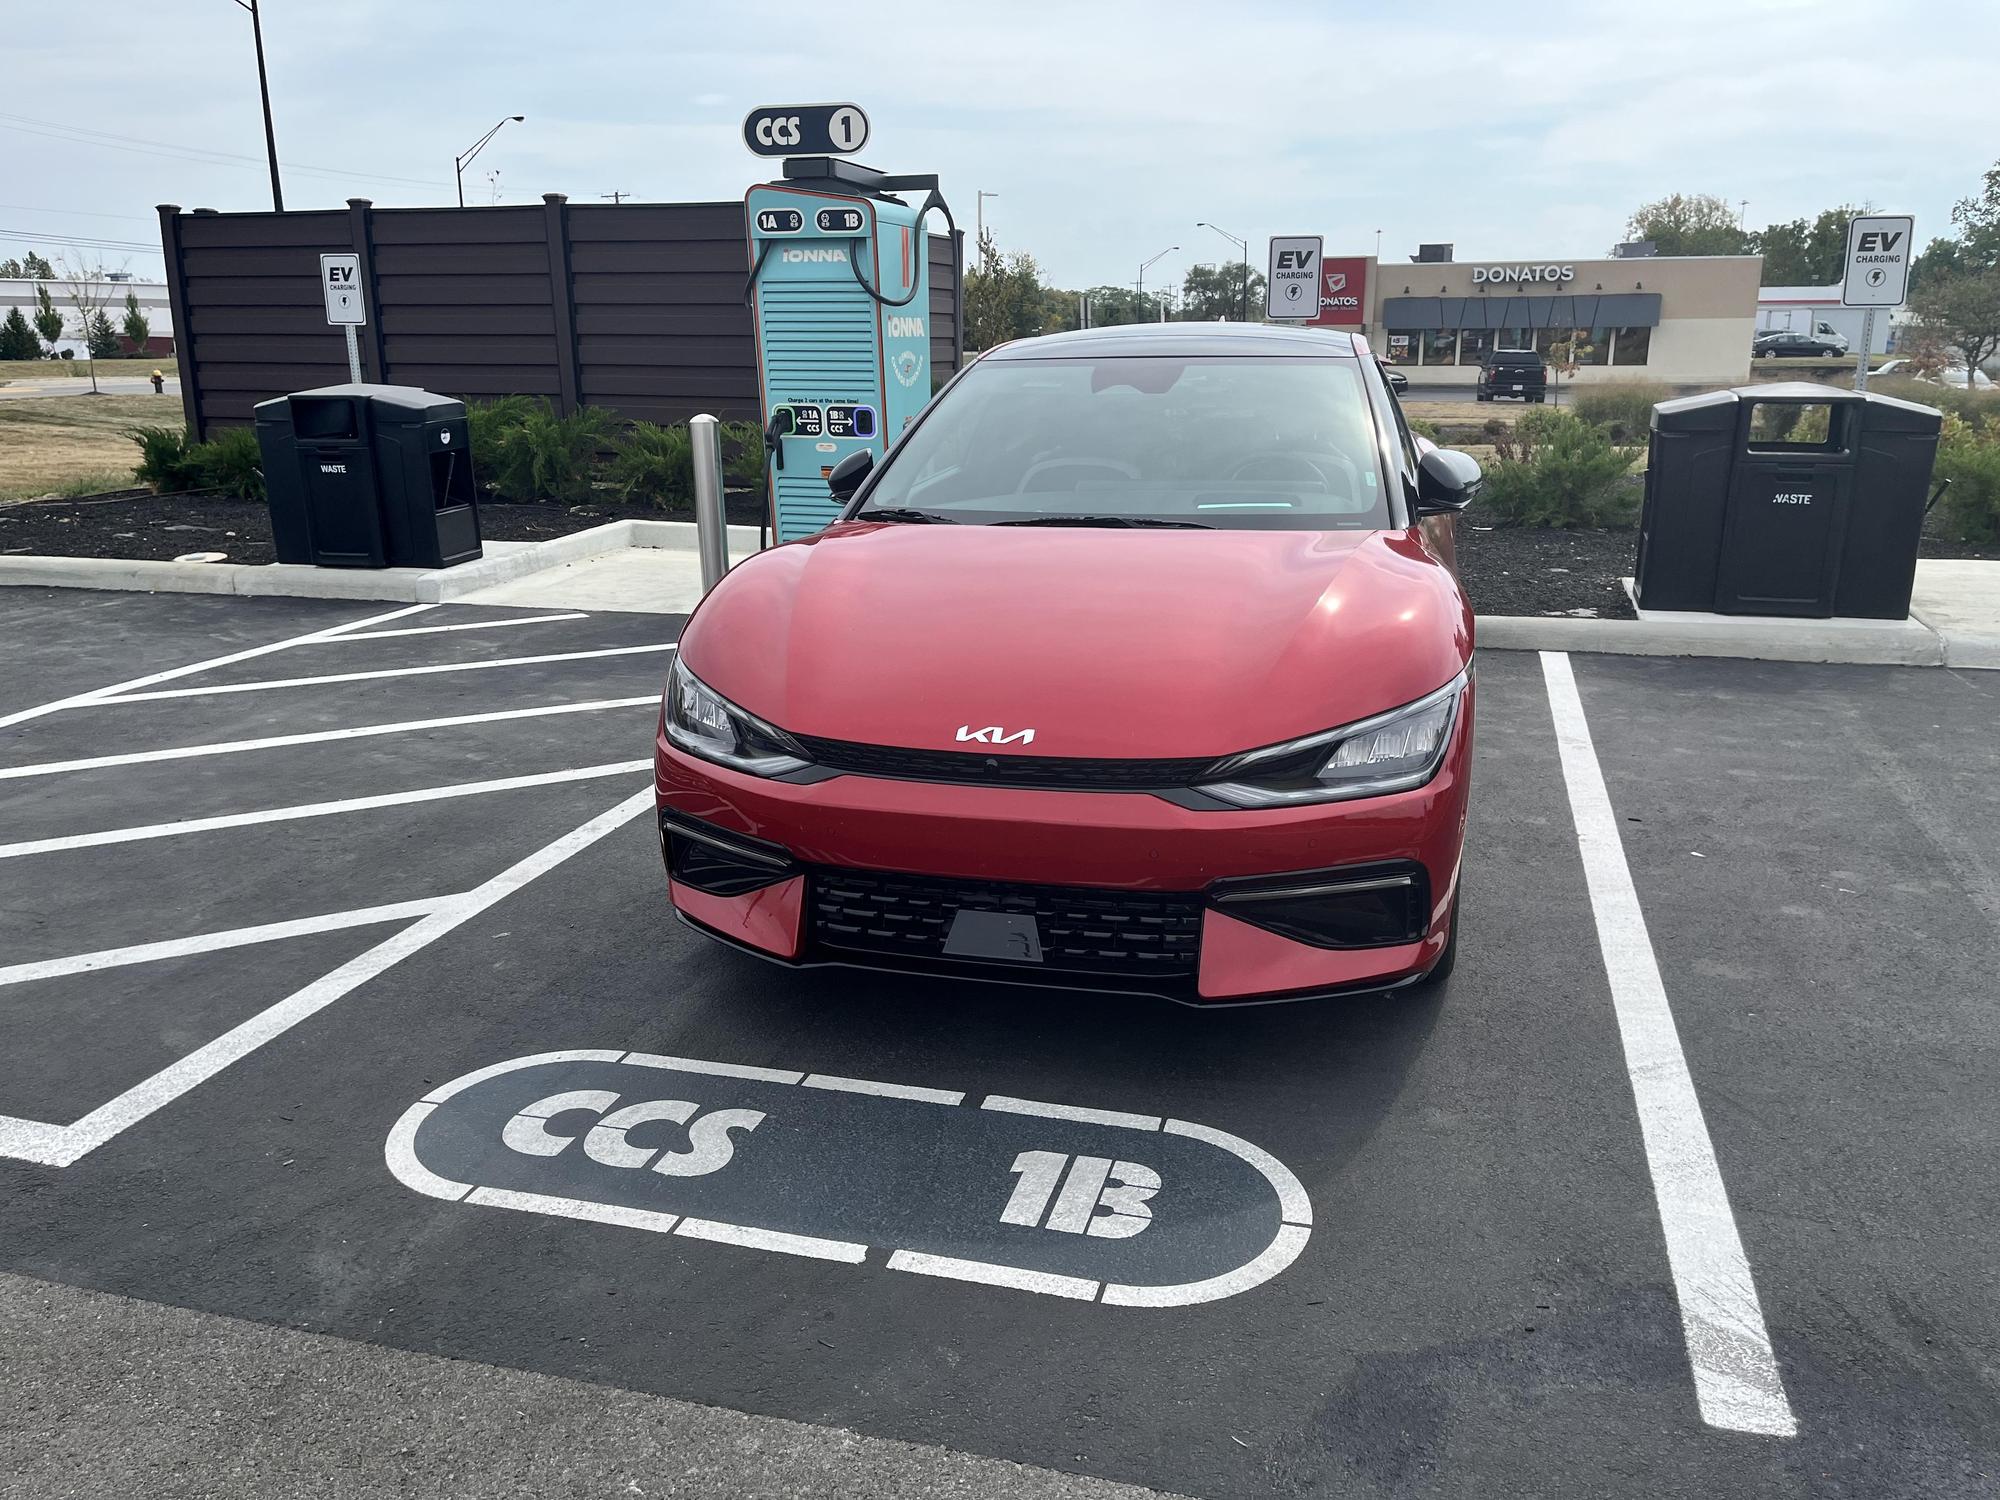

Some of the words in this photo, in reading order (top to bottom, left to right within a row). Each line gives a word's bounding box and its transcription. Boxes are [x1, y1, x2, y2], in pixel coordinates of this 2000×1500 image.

[756, 116, 801, 146] CCS
[841, 116, 851, 143] 1
[761, 214, 778, 229] 1A
[843, 213, 859, 228] 1B
[1857, 231, 1903, 252] EV
[1277, 250, 1314, 269] EV
[1855, 254, 1901, 264] CHARGING
[329, 266, 354, 282] EV
[1276, 271, 1314, 280] CHARGING
[1472, 265, 1574, 283] DONATOS
[1320, 297, 1358, 307] ONATOS
[808, 410, 819, 419] 1A
[829, 410, 839, 420] 1B
[806, 424, 820, 433] CCS
[830, 425, 844, 433] CCS
[320, 464, 347, 473] WASTE
[955, 725, 1036, 745] KIA
[502, 1089, 767, 1177] CCS
[999, 1150, 1162, 1239] 1B
